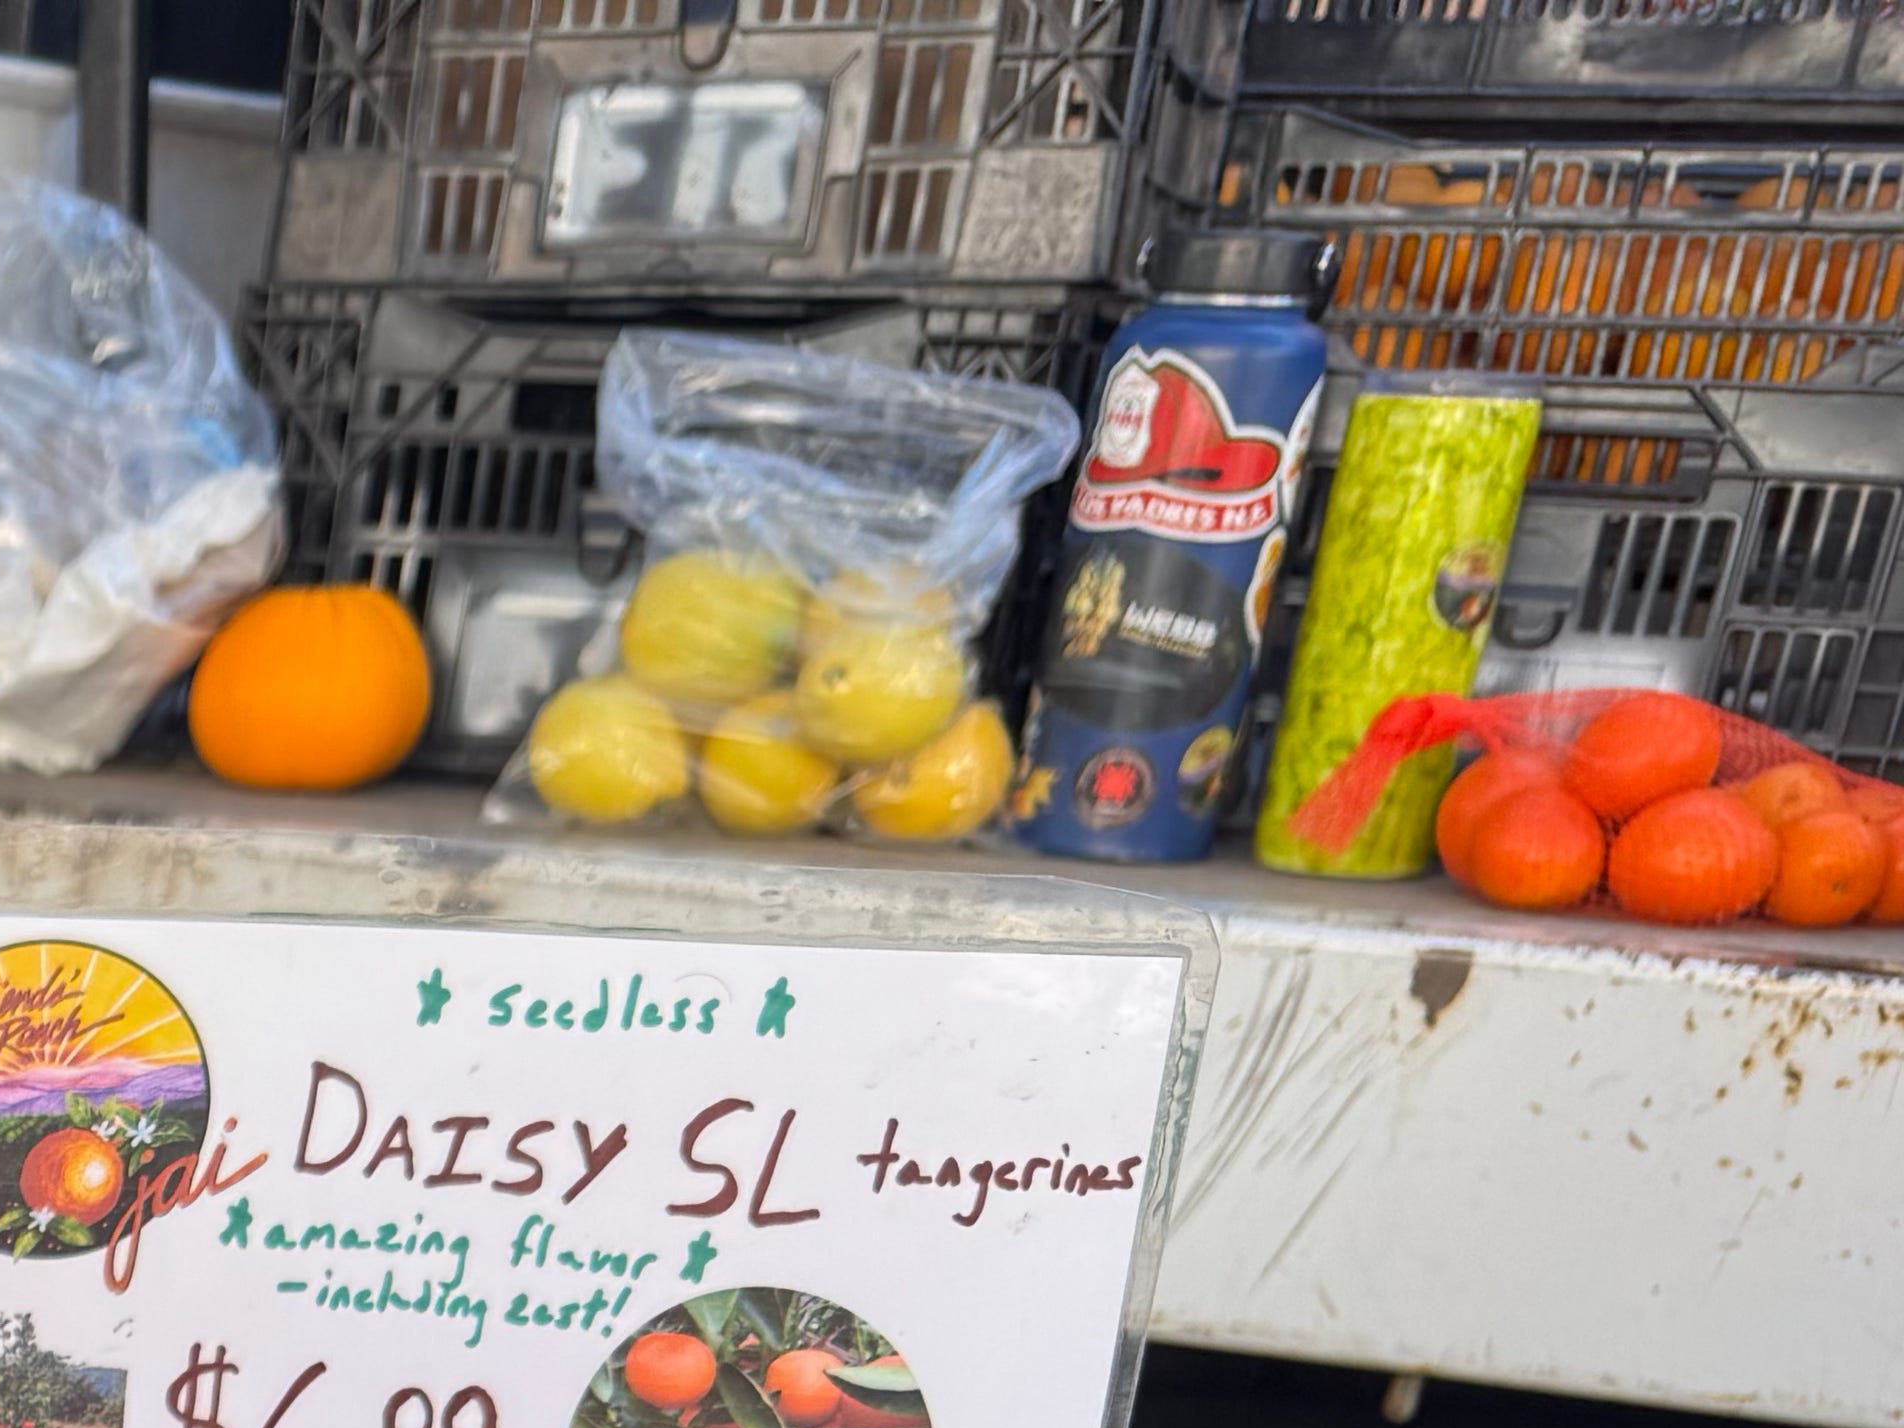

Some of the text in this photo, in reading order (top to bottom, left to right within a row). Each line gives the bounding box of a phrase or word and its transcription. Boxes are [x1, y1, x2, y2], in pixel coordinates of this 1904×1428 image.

[293, 1060, 1143, 1228] DAISY SL tangerines
[263, 1213, 658, 1290] amazing flavor
